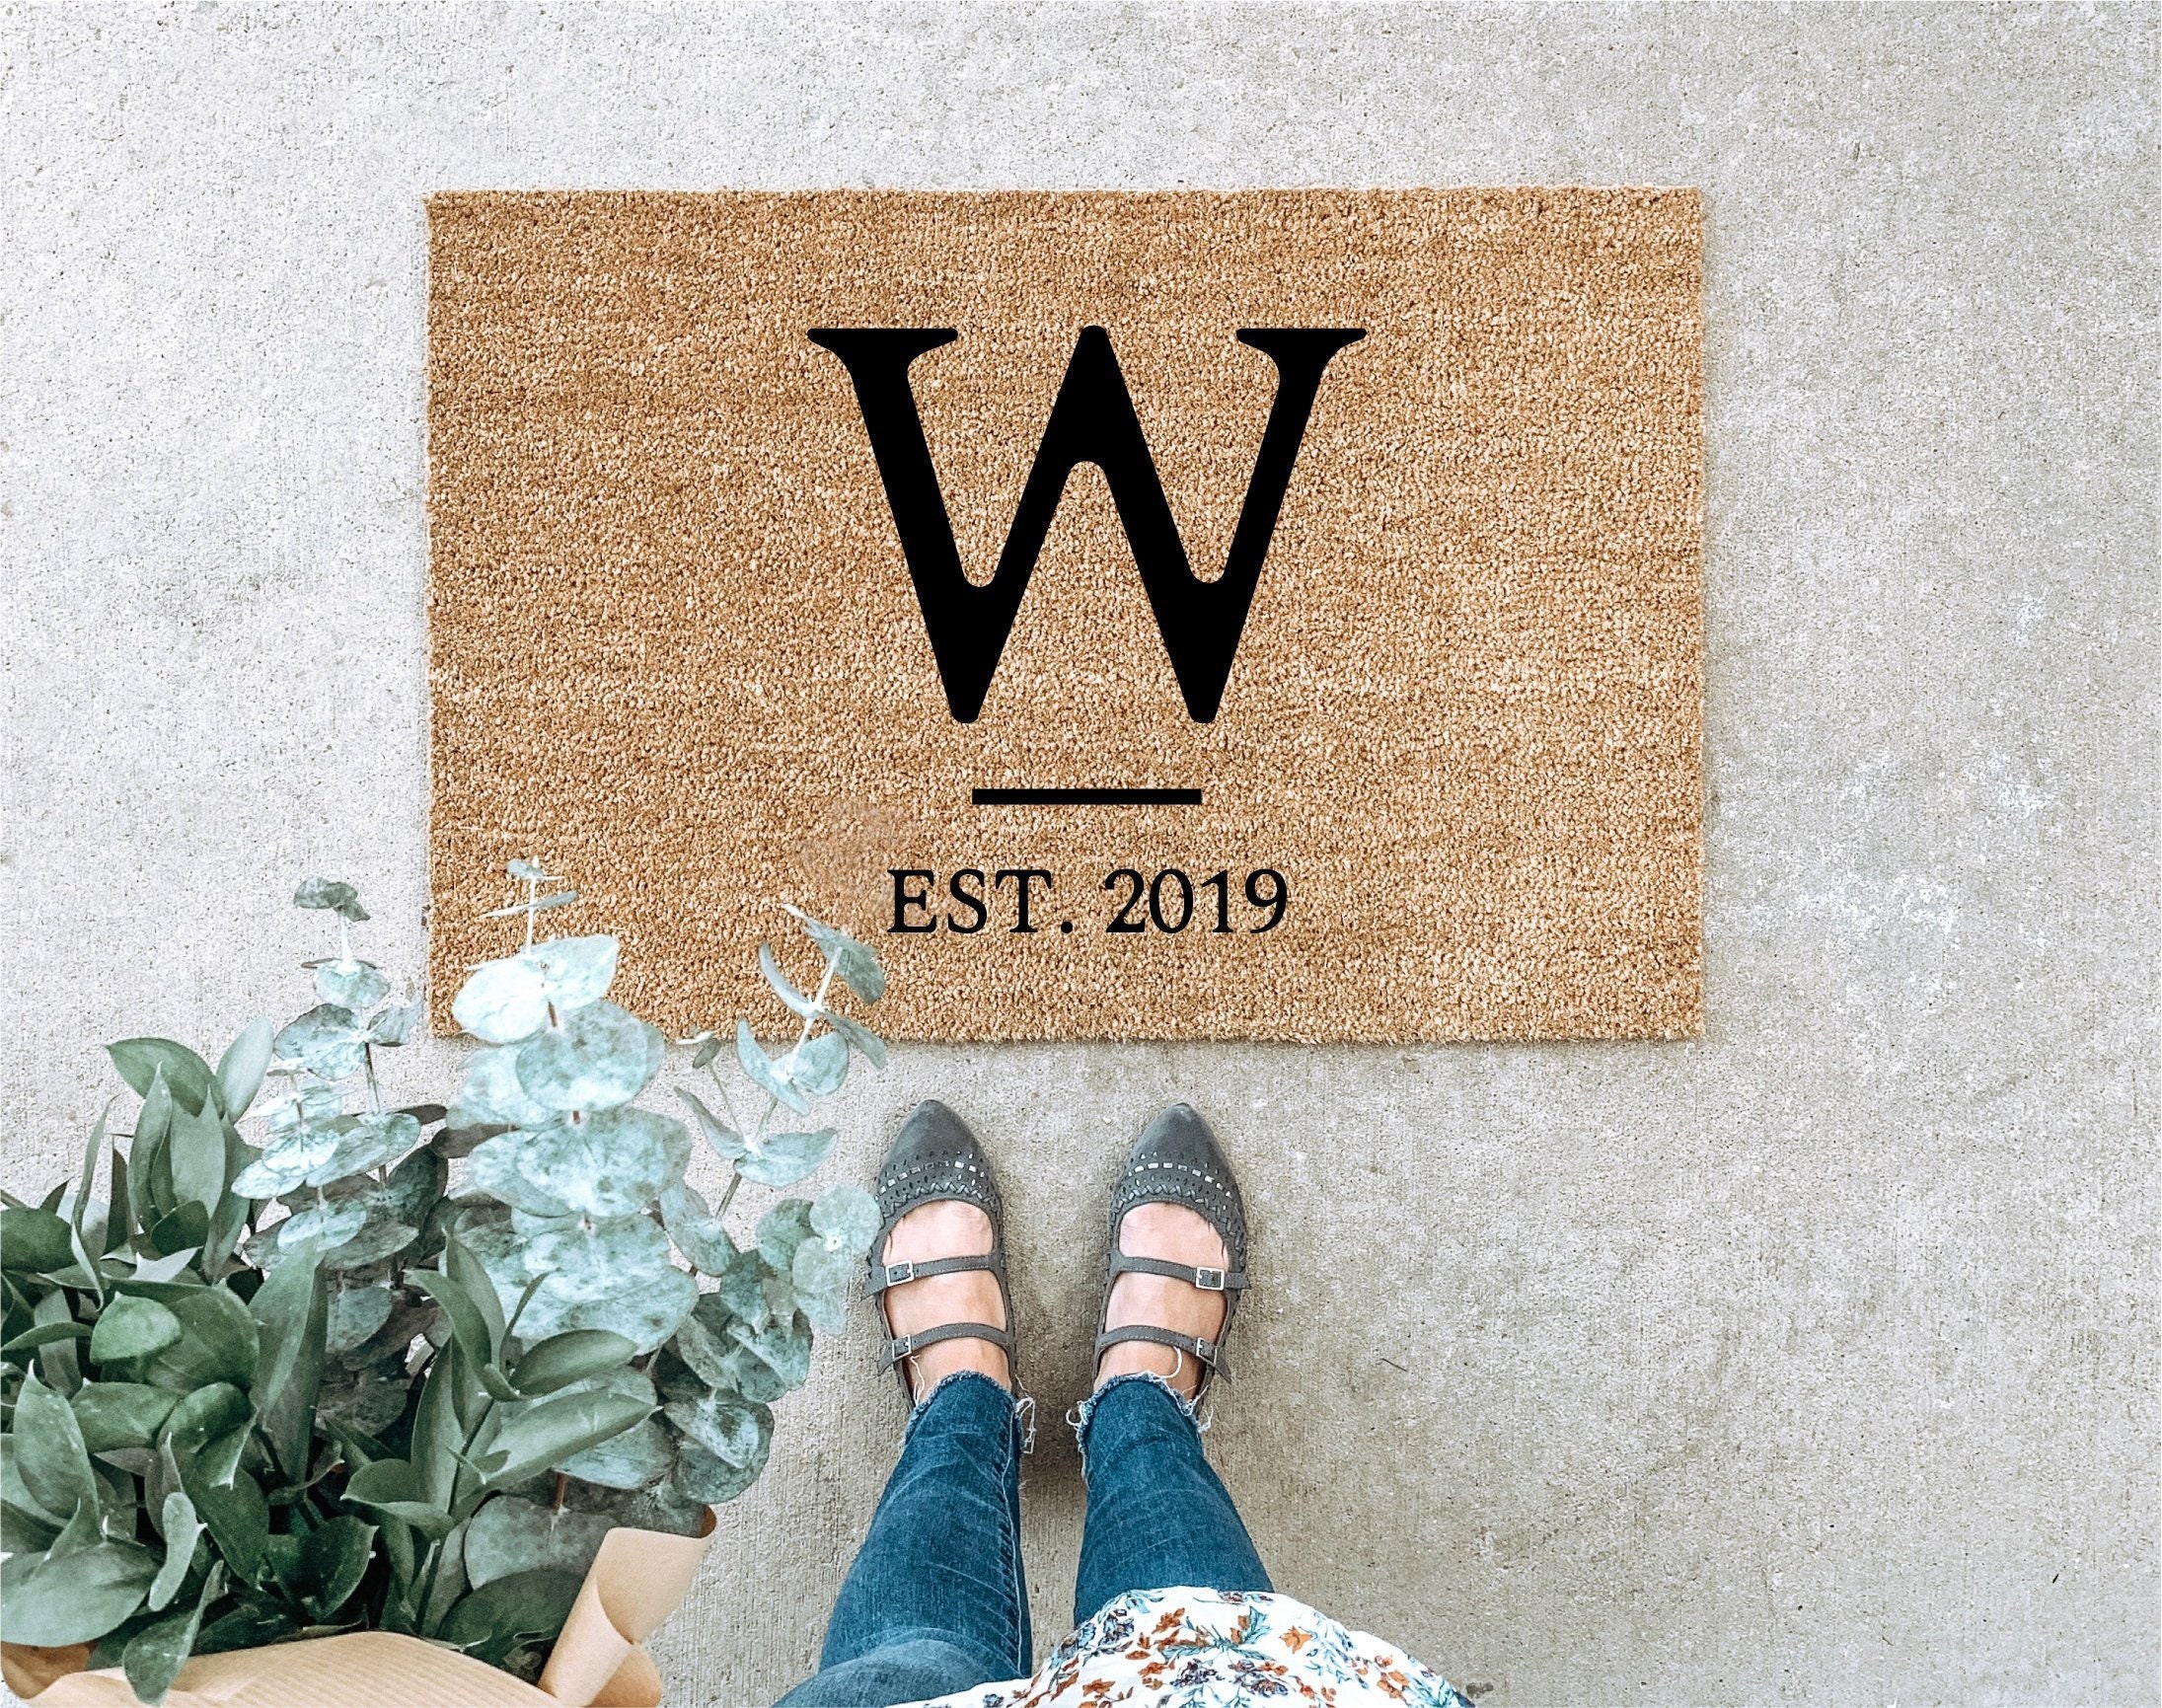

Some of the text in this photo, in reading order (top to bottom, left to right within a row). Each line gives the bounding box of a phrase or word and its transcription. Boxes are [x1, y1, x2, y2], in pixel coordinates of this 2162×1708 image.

[806, 325, 1368, 724] W
[887, 868, 1288, 934] EST. 2019
